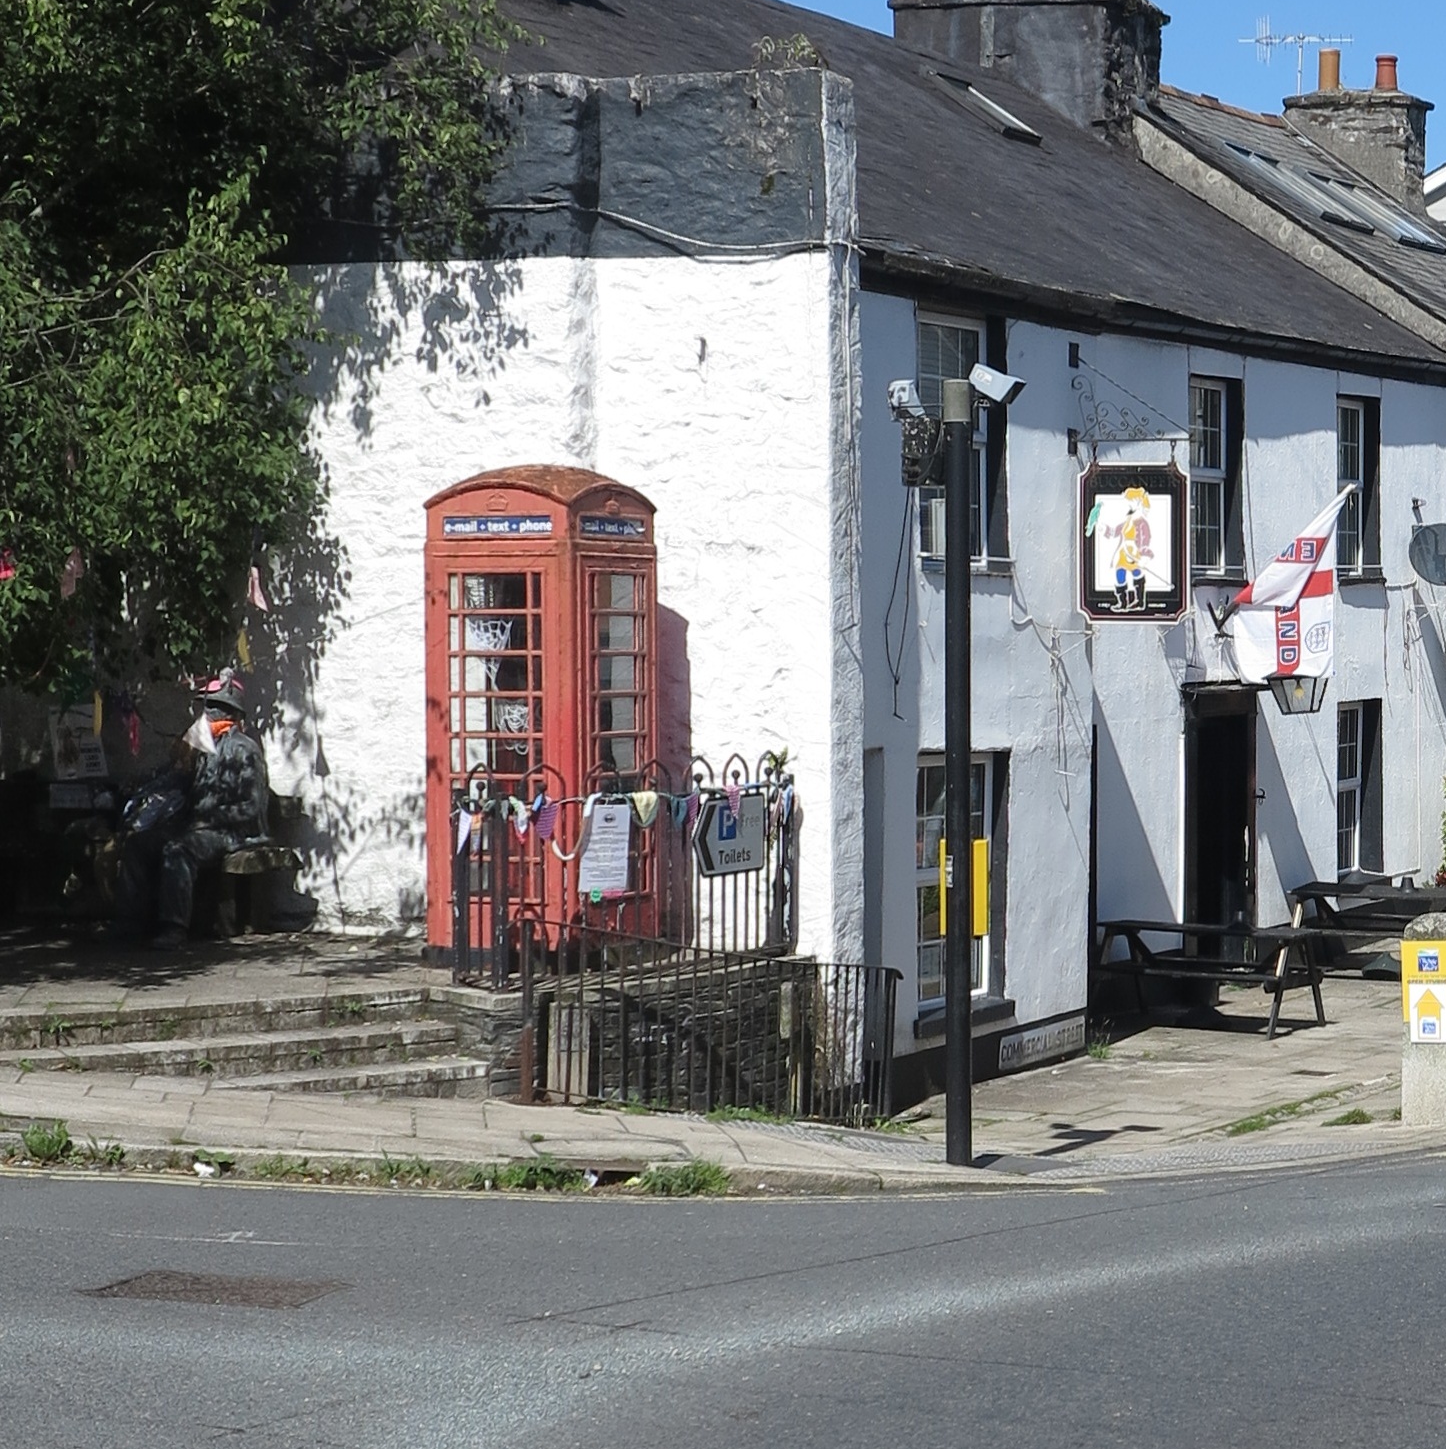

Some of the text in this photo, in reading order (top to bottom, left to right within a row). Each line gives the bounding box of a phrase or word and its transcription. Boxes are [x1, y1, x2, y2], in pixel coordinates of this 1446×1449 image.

[444, 519, 553, 534] e-mail text phone
[718, 847, 752, 866] Toilets
